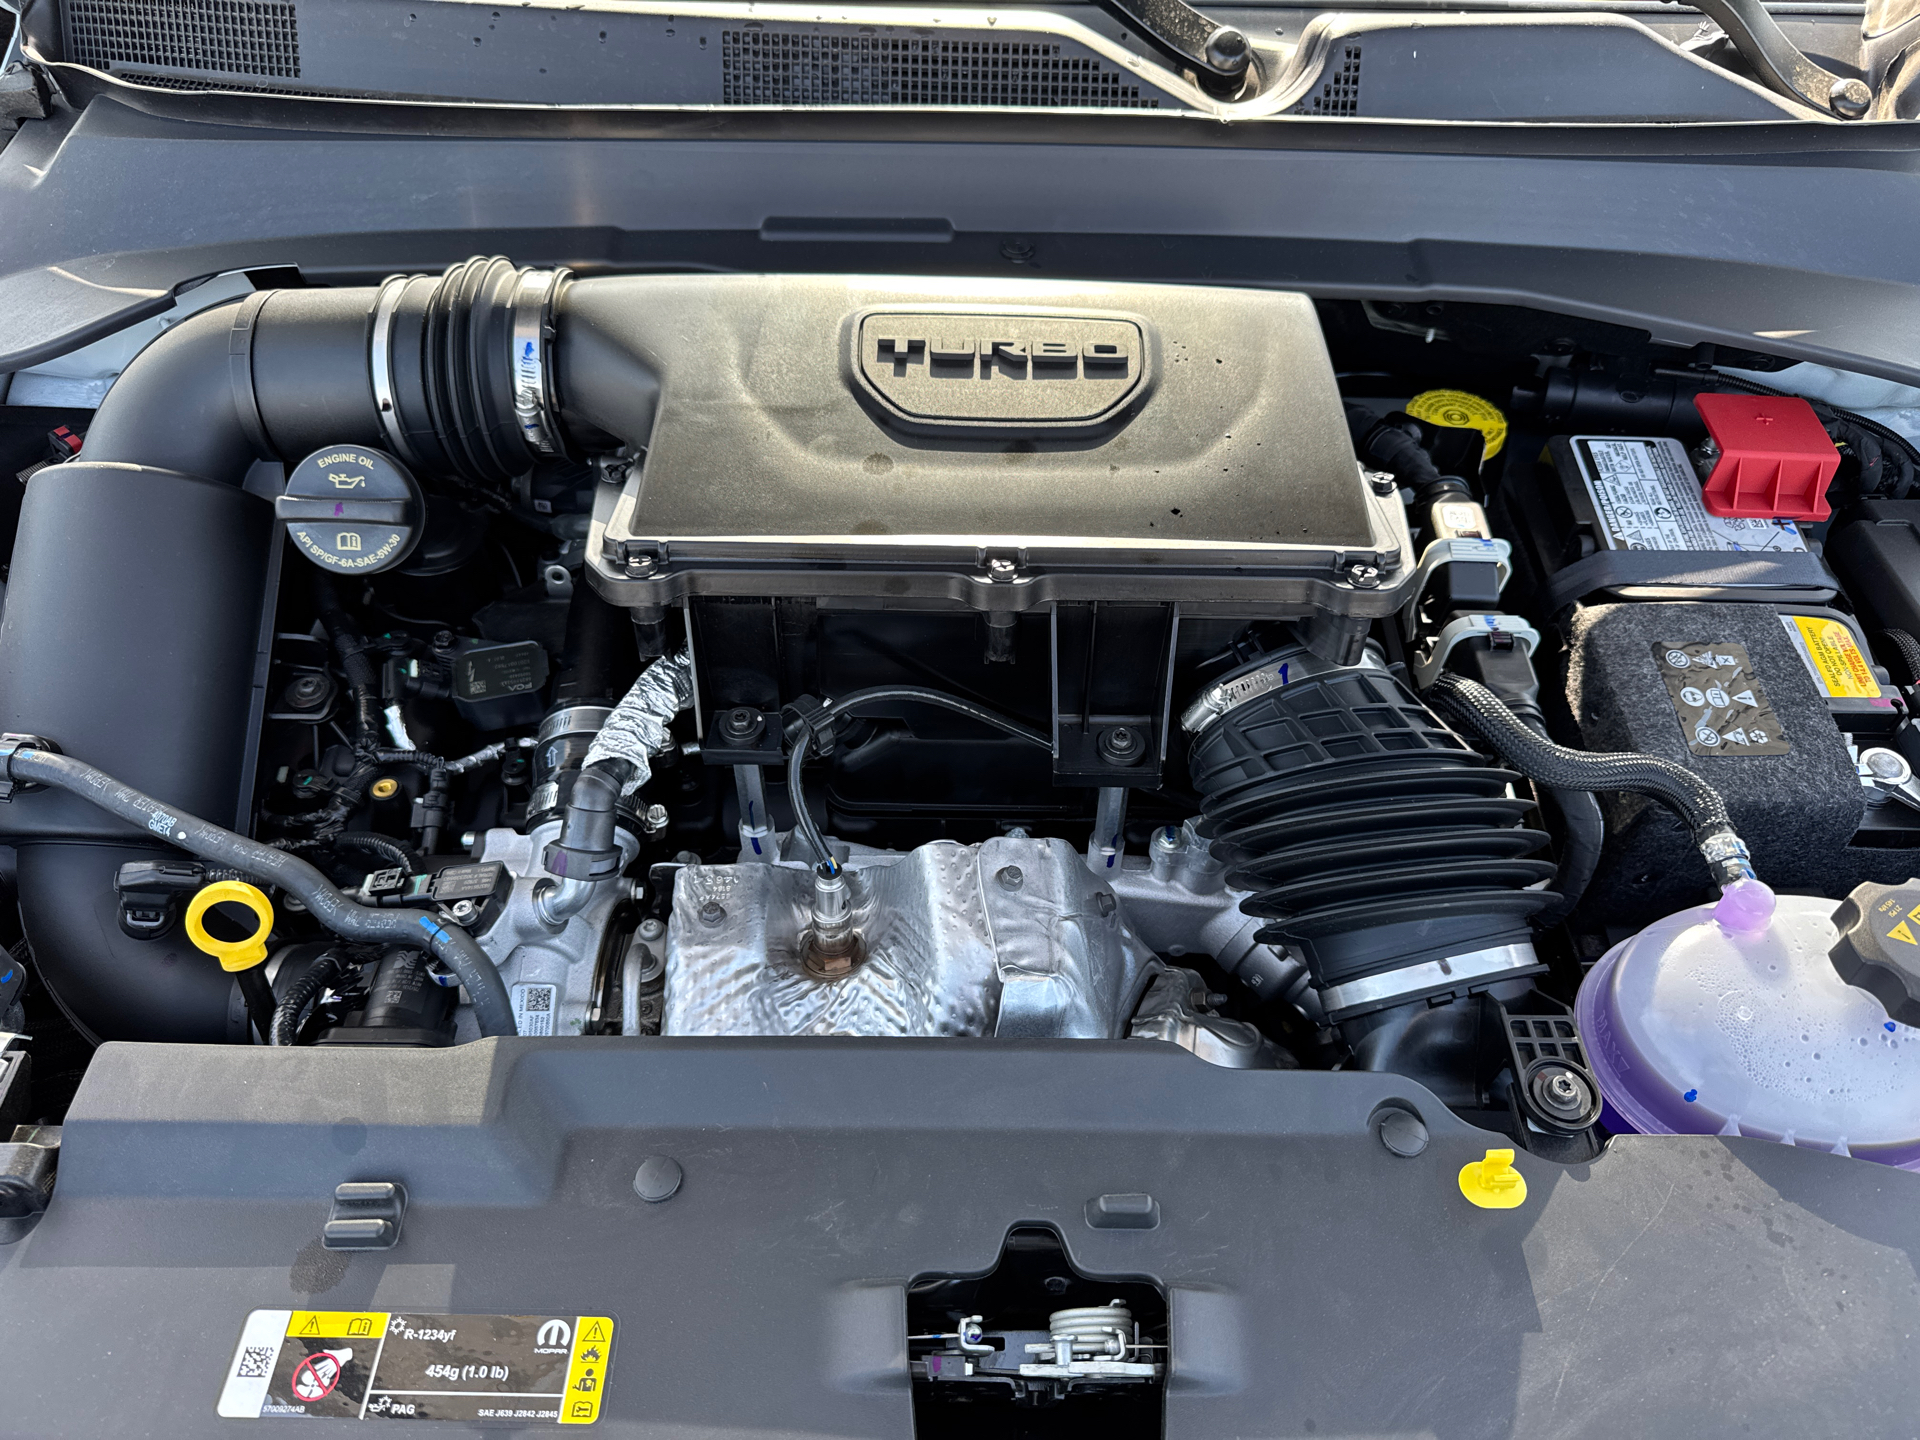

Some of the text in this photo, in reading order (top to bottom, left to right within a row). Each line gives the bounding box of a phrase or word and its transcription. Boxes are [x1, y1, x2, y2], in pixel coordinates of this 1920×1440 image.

[876, 338, 1129, 374] TURBO
[317, 453, 375, 470] ENGINE OIL
[1594, 480, 1621, 531] DANGER/POISON
[297, 531, 314, 548] API
[1806, 626, 1822, 651] BATTERY
[1817, 651, 1827, 663] AGM
[1827, 655, 1838, 667] NOT
[1844, 653, 1859, 672] CHARGE
[1826, 665, 1840, 687] SEALED
[1834, 667, 1843, 675] DO
[508, 682, 533, 691] FCA
[404, 1329, 457, 1343] R-1234yf
[425, 1365, 510, 1381] 454g (1.0 lb)
[262, 1404, 306, 1414] 57009274AB
[391, 1404, 416, 1415] PAG
[477, 1409, 558, 1418] SAE J639 J2842 J2845
